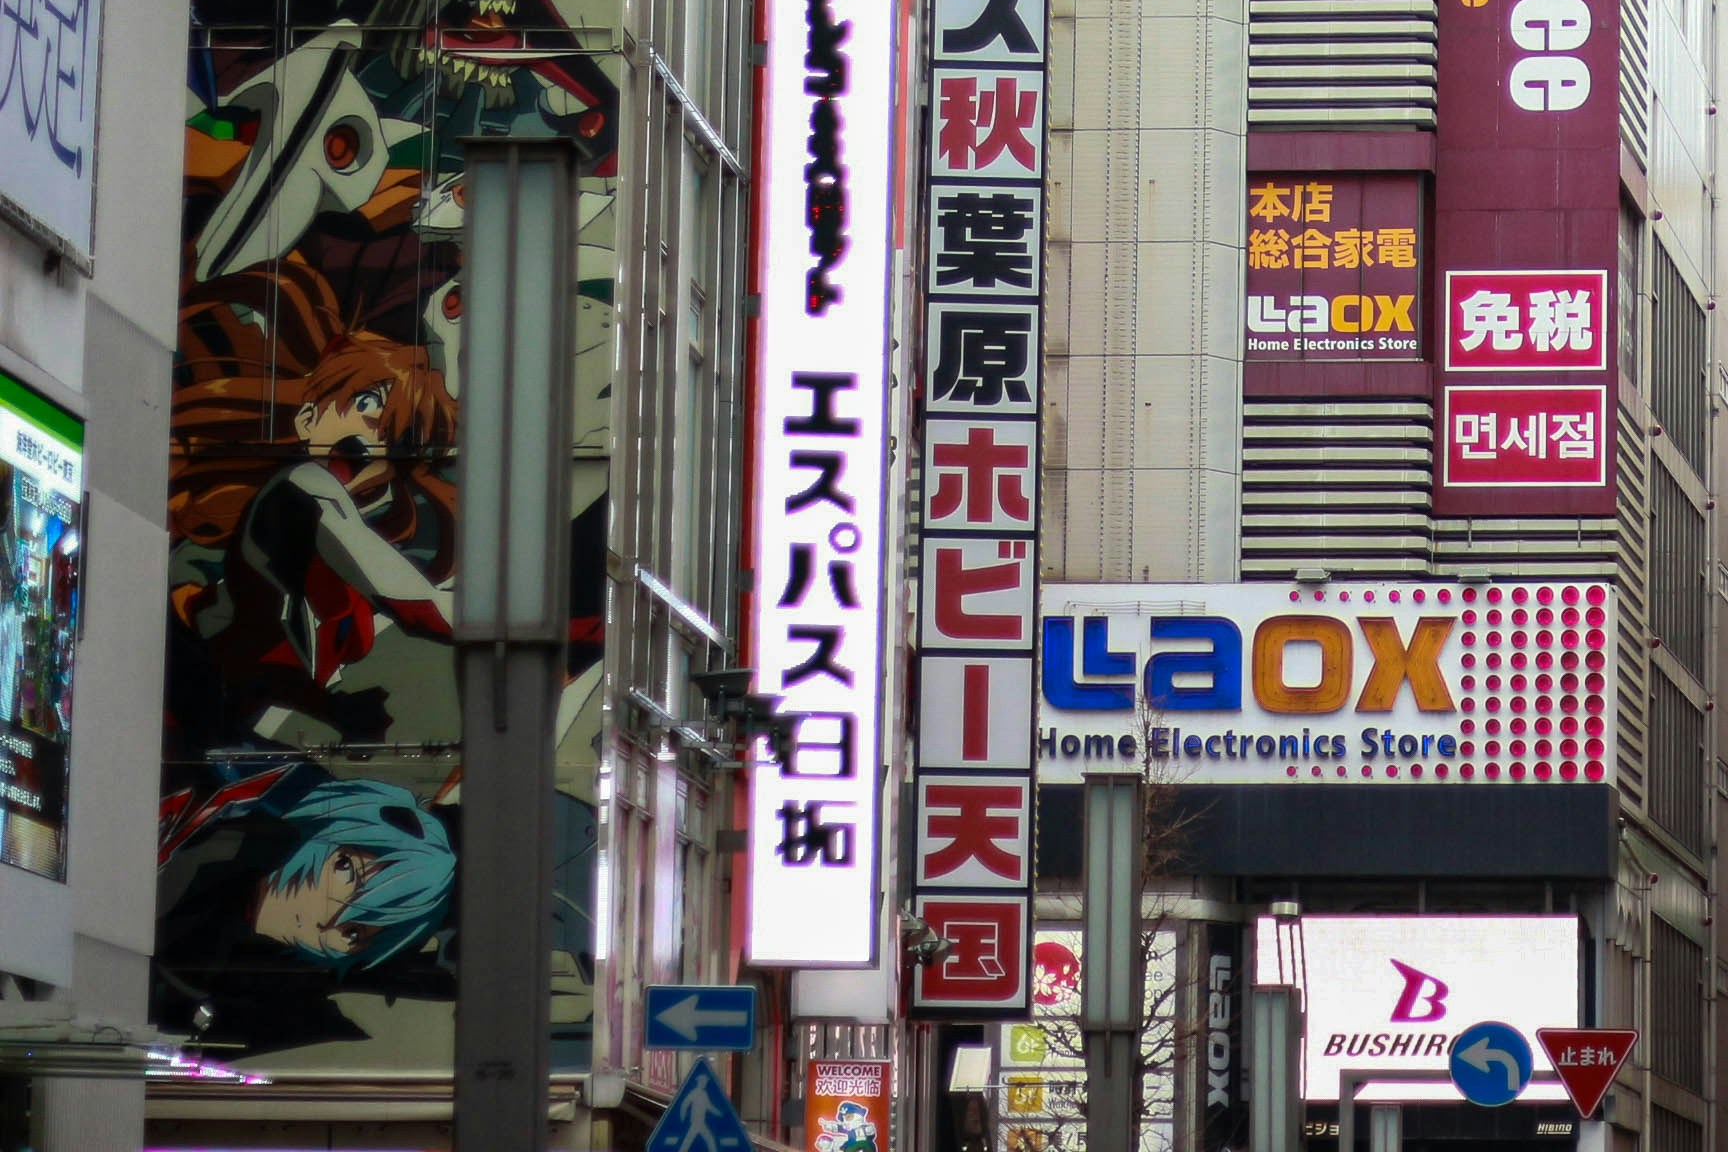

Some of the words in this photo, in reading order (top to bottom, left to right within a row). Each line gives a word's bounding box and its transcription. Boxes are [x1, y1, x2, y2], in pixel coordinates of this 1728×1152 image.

[1249, 182, 1334, 223] 本店
[1248, 227, 1417, 270] 総合家電
[1459, 288, 1594, 353] 免税
[1247, 337, 1290, 351] Home
[1293, 336, 1375, 351] Electronics
[1378, 336, 1418, 351] Store
[1454, 411, 1596, 460] 면세점
[1039, 726, 1136, 759] Home
[1150, 726, 1346, 759] Electronics
[1360, 727, 1457, 759] Store
[817, 1064, 882, 1078] WELCOME
[1558, 1048, 1617, 1066] 止まれ
[815, 1078, 882, 1097] 欢迎光临
